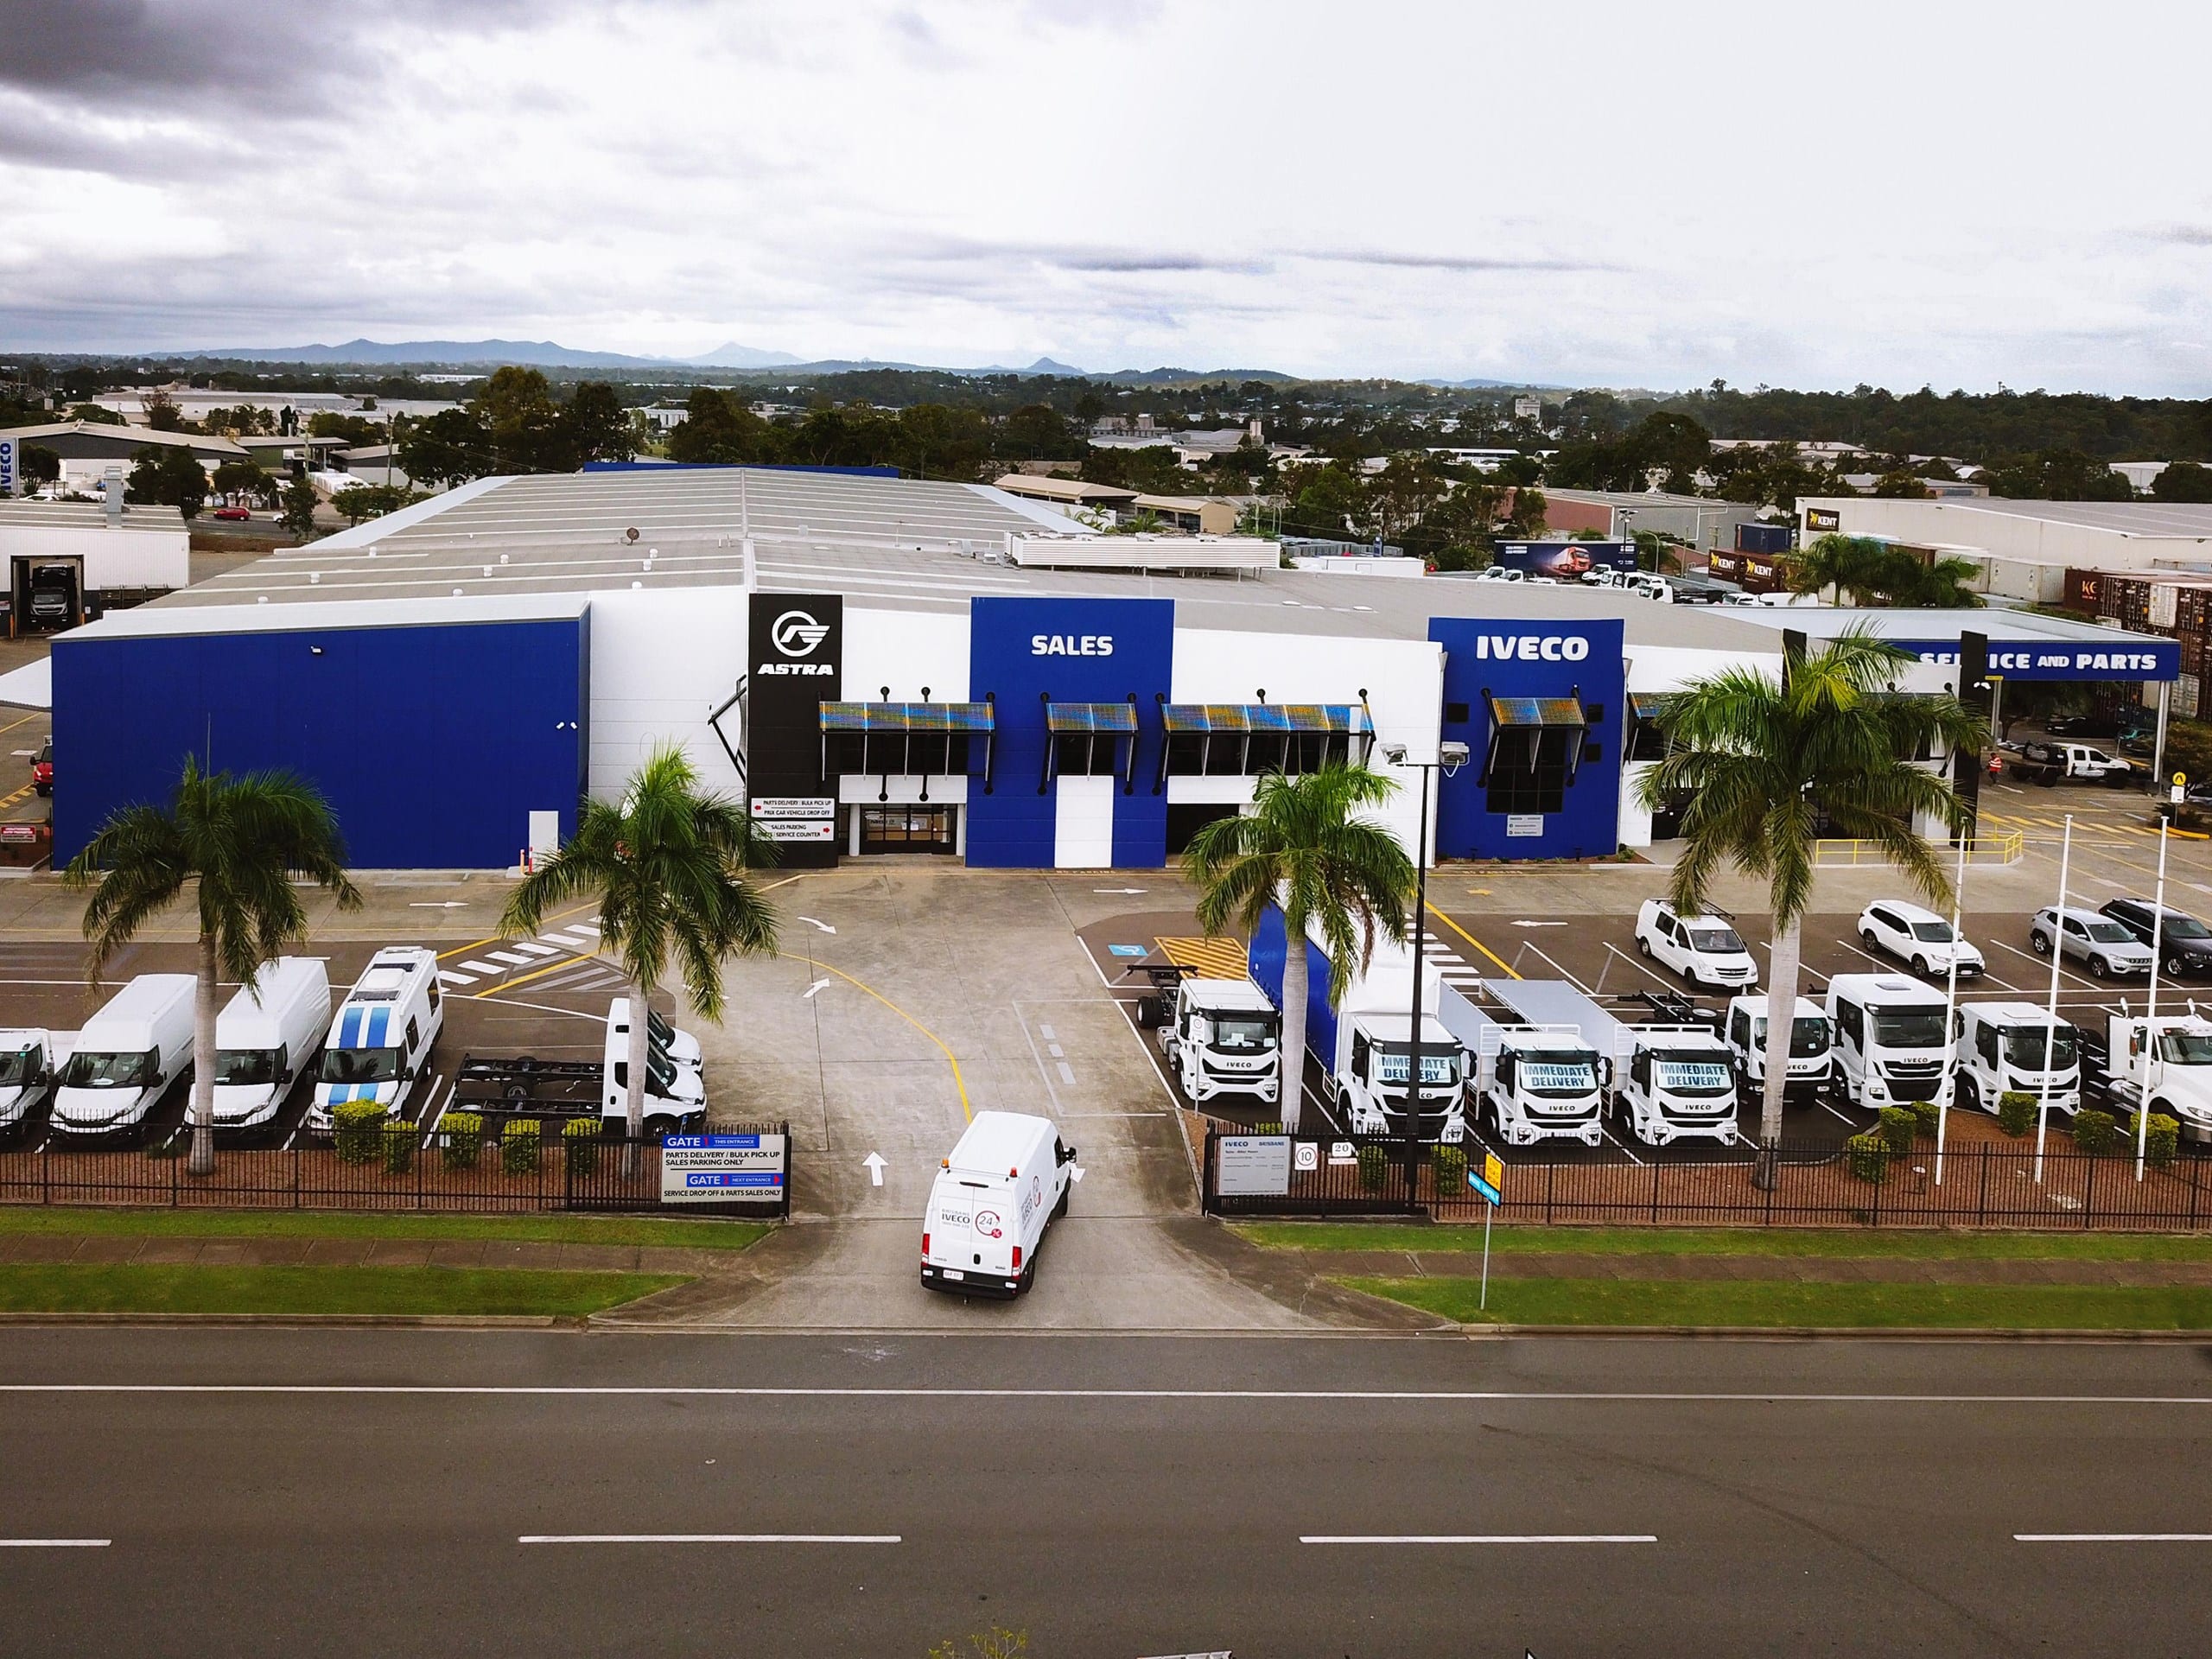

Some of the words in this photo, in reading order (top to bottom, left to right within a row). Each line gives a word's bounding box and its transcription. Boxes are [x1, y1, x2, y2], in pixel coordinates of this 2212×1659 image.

[0, 442, 11, 491] IVECO
[1817, 516, 1837, 526] KENT
[1718, 558, 1736, 569] KENT
[1754, 565, 1773, 576] KENT
[1031, 635, 1113, 656] SALES
[1477, 636, 1589, 661] IVECO
[1920, 653, 2031, 669] SEICE
[2037, 656, 2070, 668] AND
[2076, 654, 2157, 670] PARTS
[757, 664, 834, 676] ASTRA
[1378, 1056, 1446, 1069] IMMEIATE
[1384, 1069, 1440, 1080] DELIERY
[1524, 1065, 1591, 1077] IMMEDIATE
[1660, 1064, 1726, 1076] IMMEDIATE
[1532, 1077, 1586, 1087] DELIVERY
[1667, 1076, 1721, 1086] DELIVERY
[667, 1137, 701, 1147] GATE
[704, 1137, 709, 1147] 1
[1300, 1151, 1312, 1161] 10
[690, 1176, 721, 1185] GATE
[942, 1213, 970, 1224] IVECO
